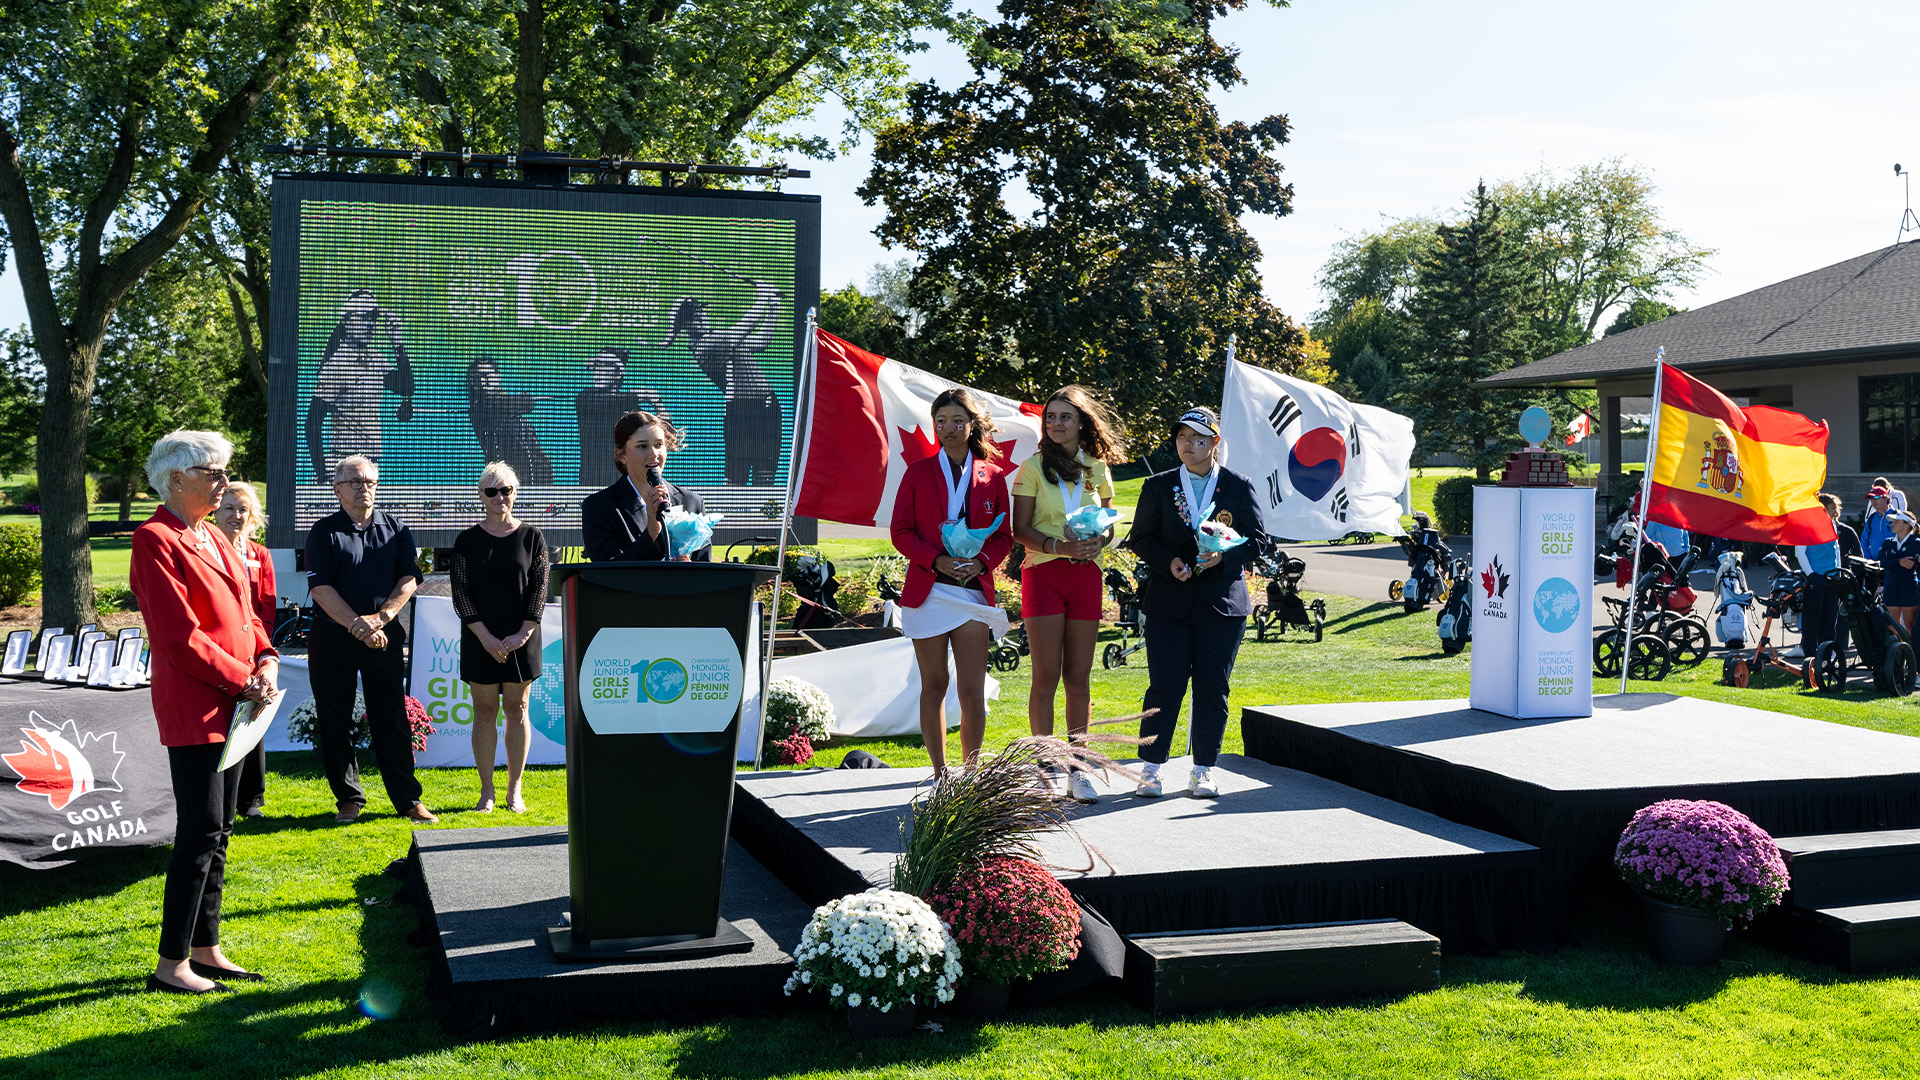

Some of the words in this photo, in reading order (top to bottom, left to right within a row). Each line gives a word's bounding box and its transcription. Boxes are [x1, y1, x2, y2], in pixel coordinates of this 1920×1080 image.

[1542, 513, 1576, 522] WORLD
[1541, 522, 1574, 531] JUNIOR
[1541, 532, 1574, 543] GIRLS
[1541, 543, 1574, 555] GOLF
[1488, 601, 1503, 610] GOLF
[1483, 608, 1508, 620] CANADA
[593, 659, 631, 668] WORLD
[1538, 656, 1574, 665] MONDIAL
[593, 667, 630, 677] JUNIOR
[691, 664, 731, 672] MONDIAL
[1538, 665, 1574, 676] JUNIOR
[690, 672, 730, 682] JUNIOR
[1538, 675, 1574, 686] FÉMININ
[592, 677, 630, 688] GIRLS
[691, 682, 730, 691] FÉMININ
[592, 688, 630, 699] GOLF
[690, 692, 703, 701] DE
[704, 691, 729, 700] GOLF
[1538, 687, 1550, 696] DE
[1550, 686, 1574, 696] GOLF
[66, 800, 124, 826] GOLF
[51, 817, 148, 851] CANADA
